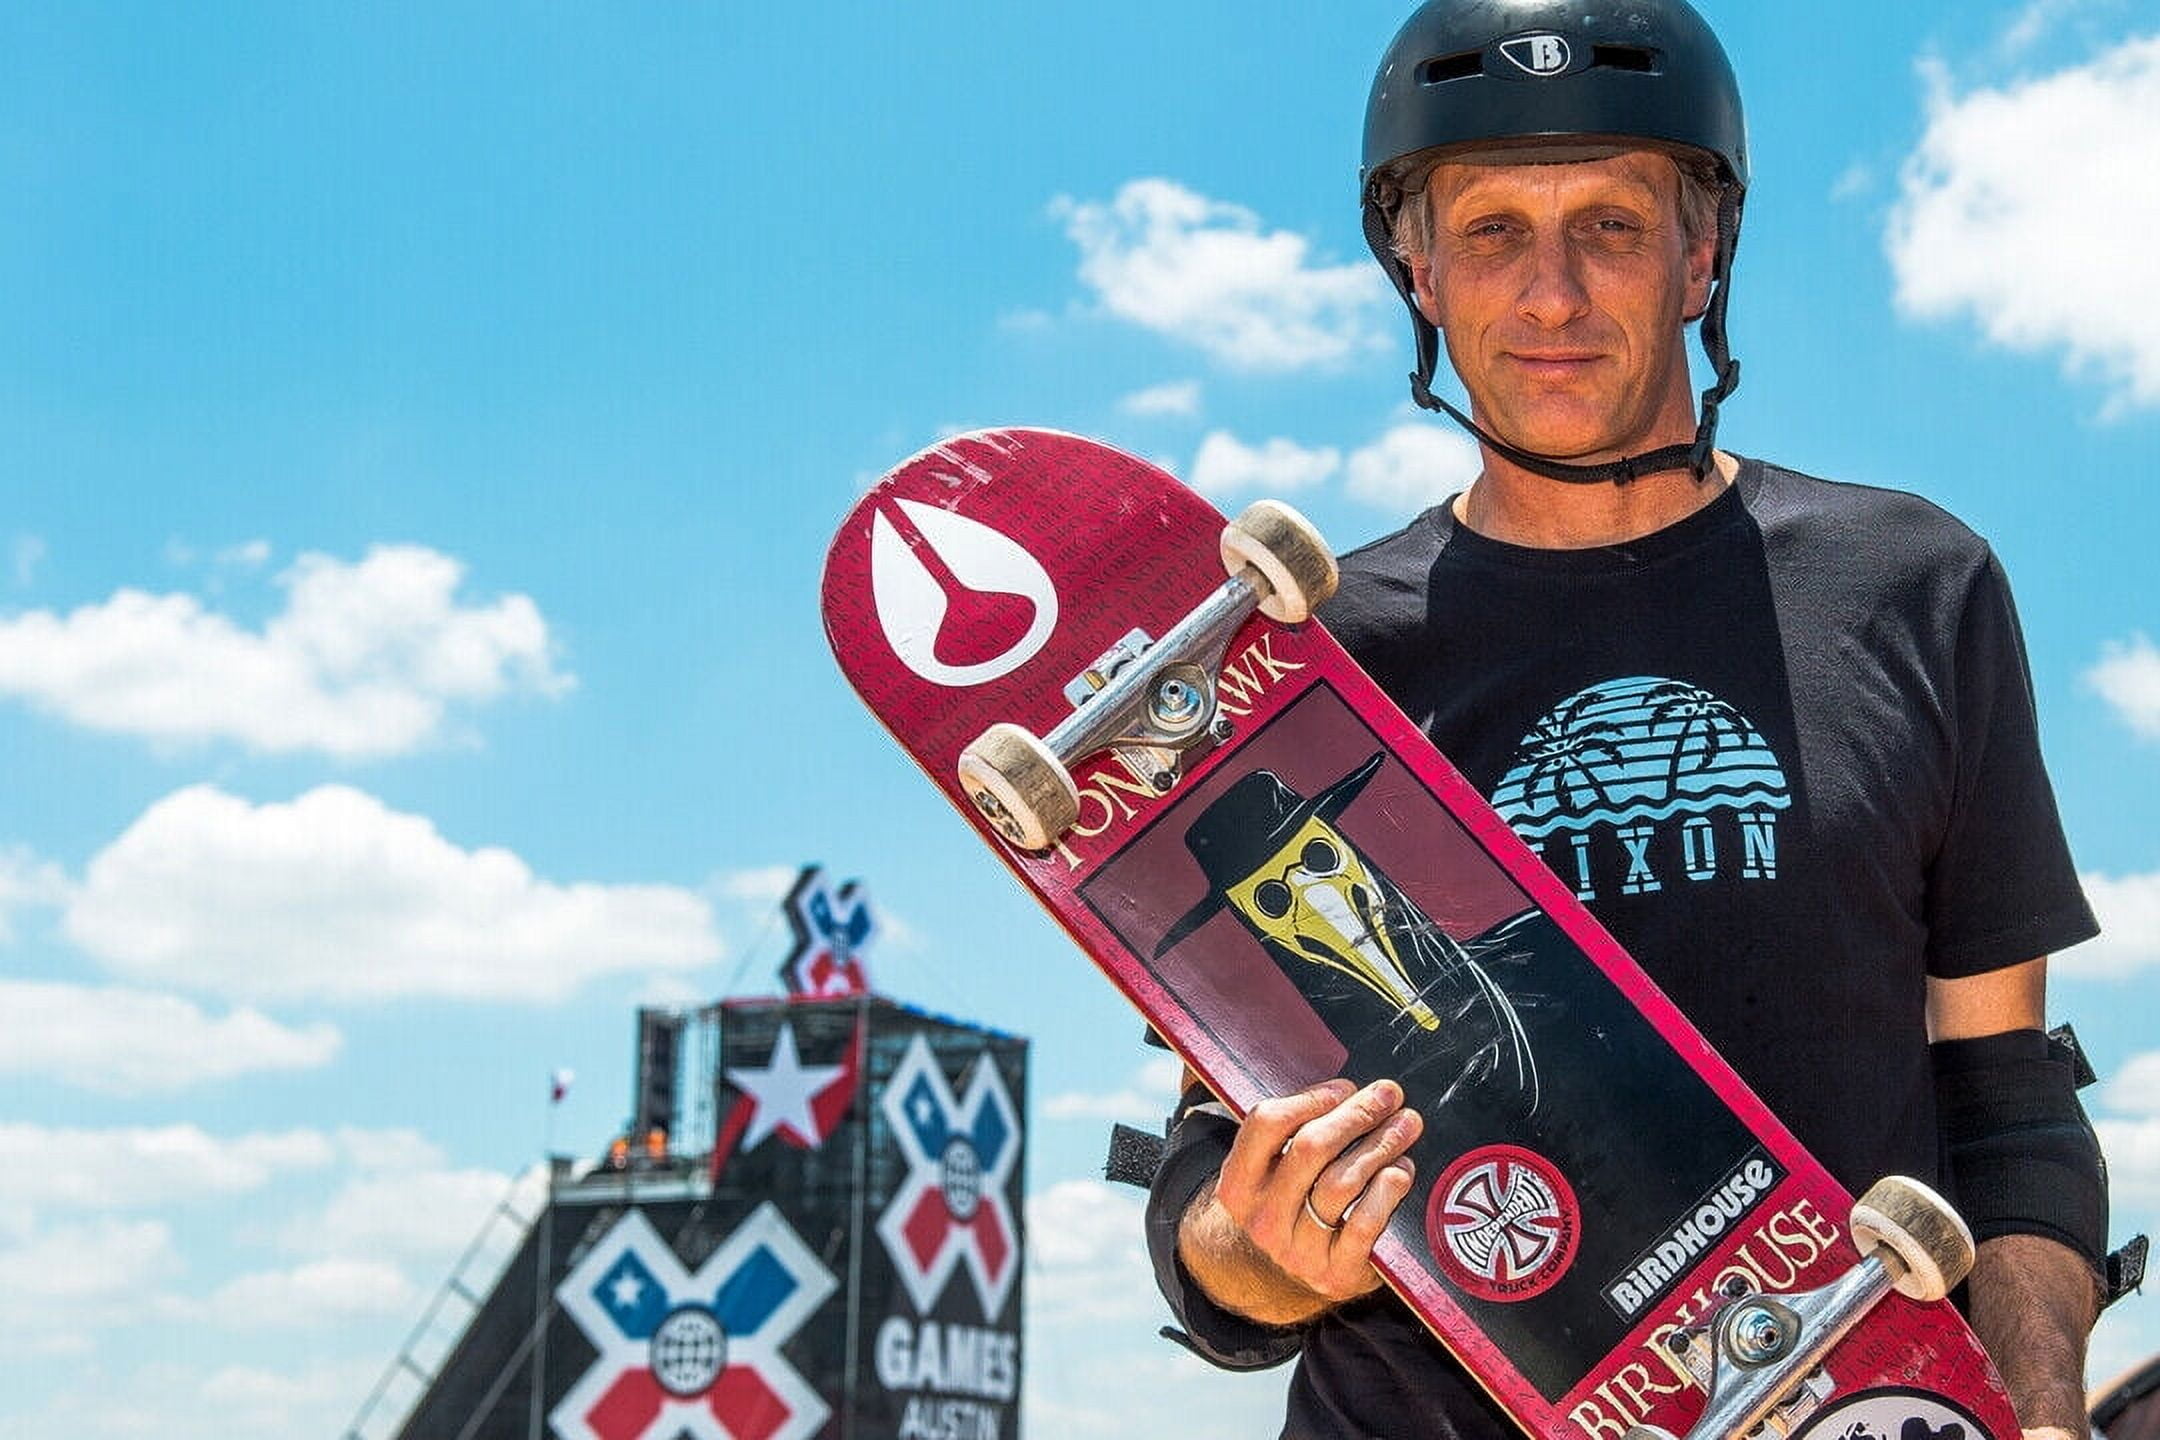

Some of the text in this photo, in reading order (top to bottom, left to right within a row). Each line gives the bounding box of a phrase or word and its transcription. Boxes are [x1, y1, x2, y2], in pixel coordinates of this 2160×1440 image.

[1531, 35, 1562, 70] B
[1530, 812, 1777, 901] IXON
[1454, 1173, 1551, 1270] INDEPENDENT
[1539, 1208, 1573, 1281] COMPANY
[874, 1314, 1018, 1403] GAMES
[1567, 1198, 1841, 1440] BIRDOUSE
[898, 1397, 1000, 1440] AUSTIN
